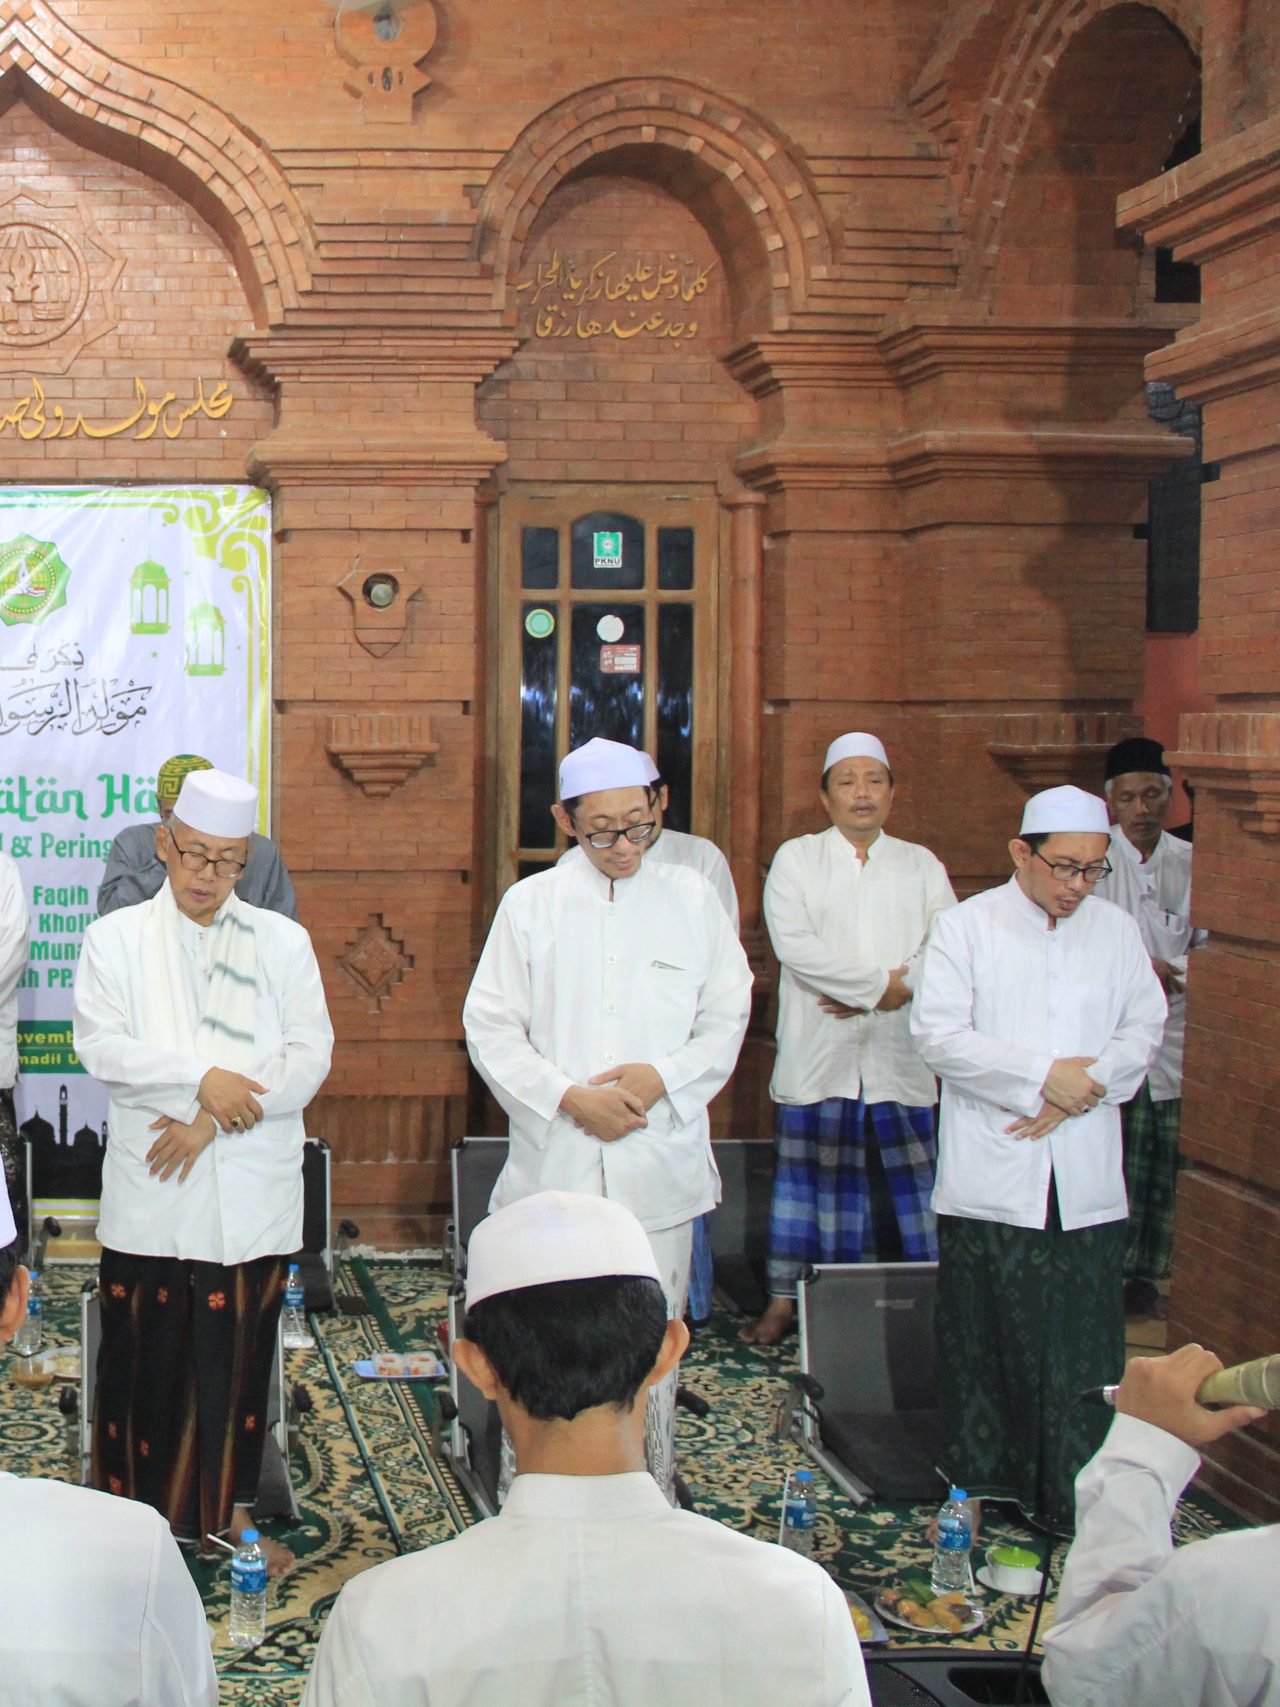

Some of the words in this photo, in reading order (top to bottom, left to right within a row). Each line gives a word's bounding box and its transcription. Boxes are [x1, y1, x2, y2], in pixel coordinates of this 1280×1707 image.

[594, 557, 621, 565] PKNU
[11, 834, 33, 859] &
[33, 885, 89, 907] Faqih
